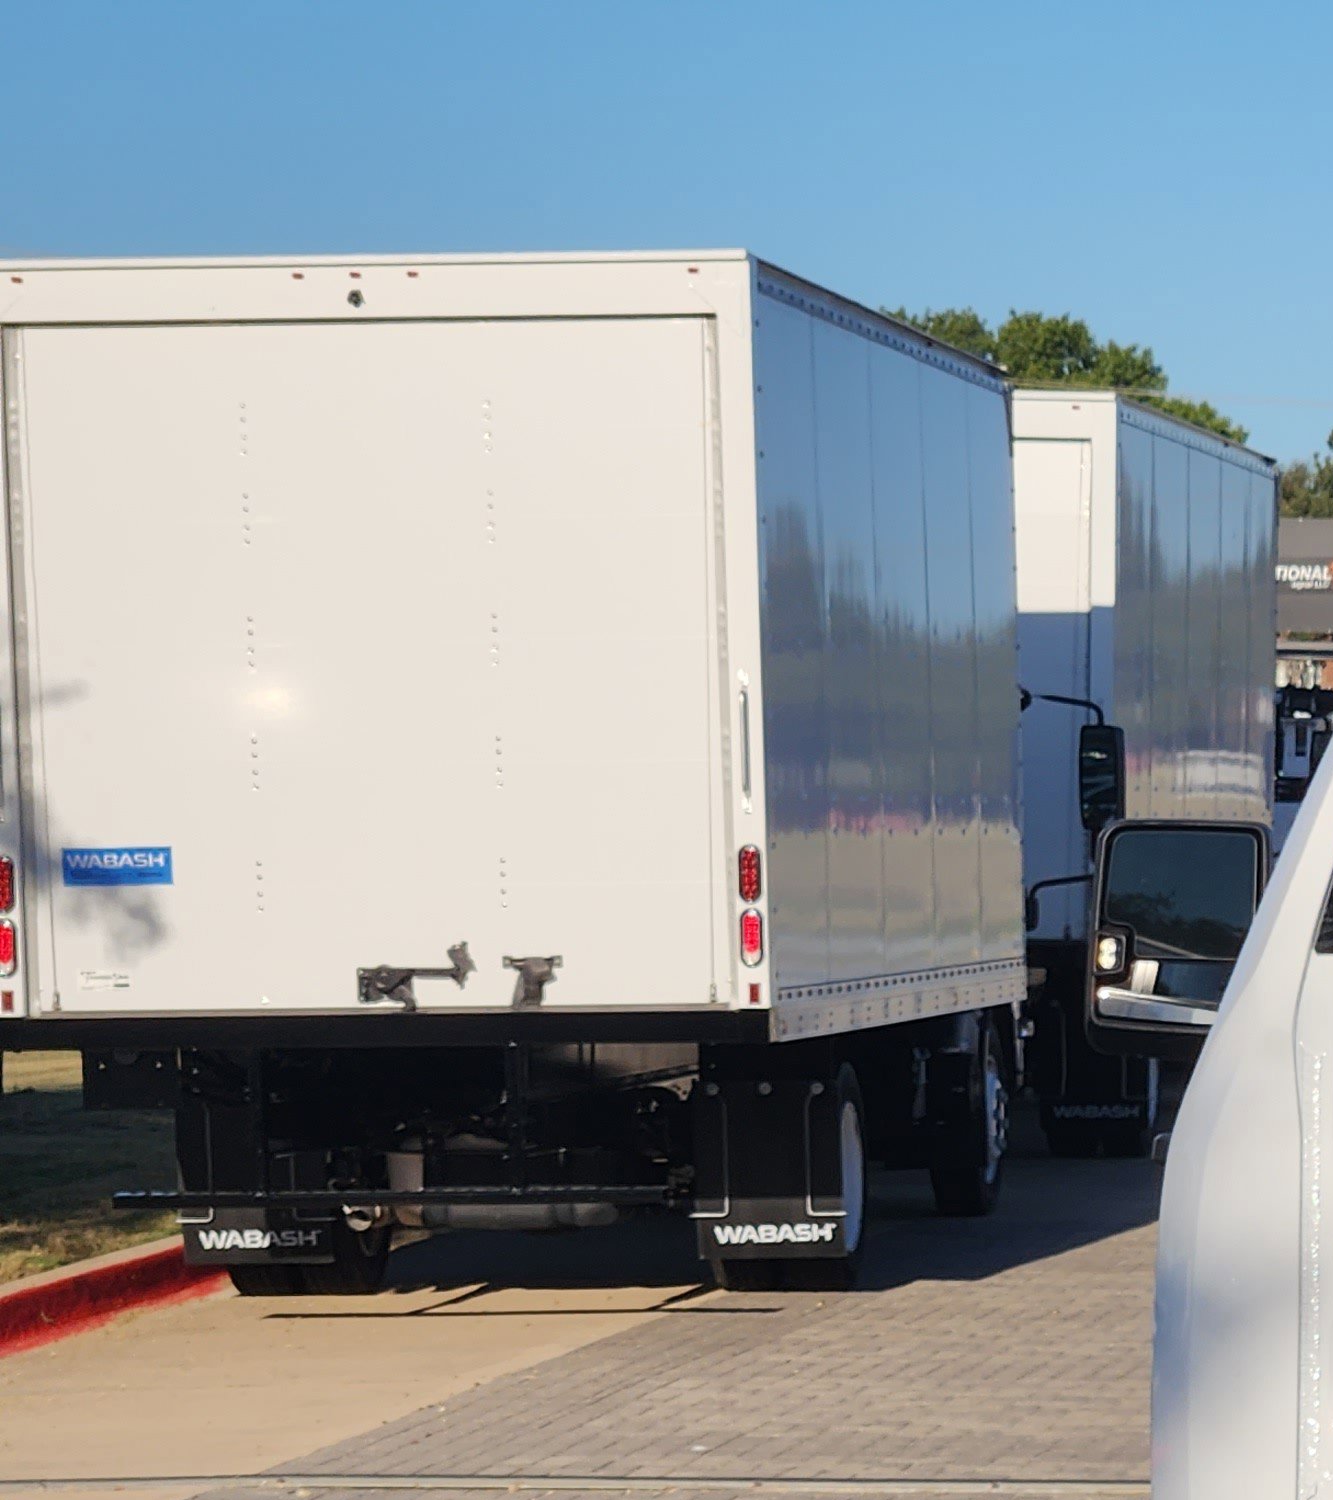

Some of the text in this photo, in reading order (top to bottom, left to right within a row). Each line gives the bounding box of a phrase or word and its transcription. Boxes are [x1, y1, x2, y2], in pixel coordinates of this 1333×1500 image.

[66, 852, 166, 869] WABASH
[199, 1229, 322, 1250] WABASH
[714, 1223, 837, 1244] WABASH
